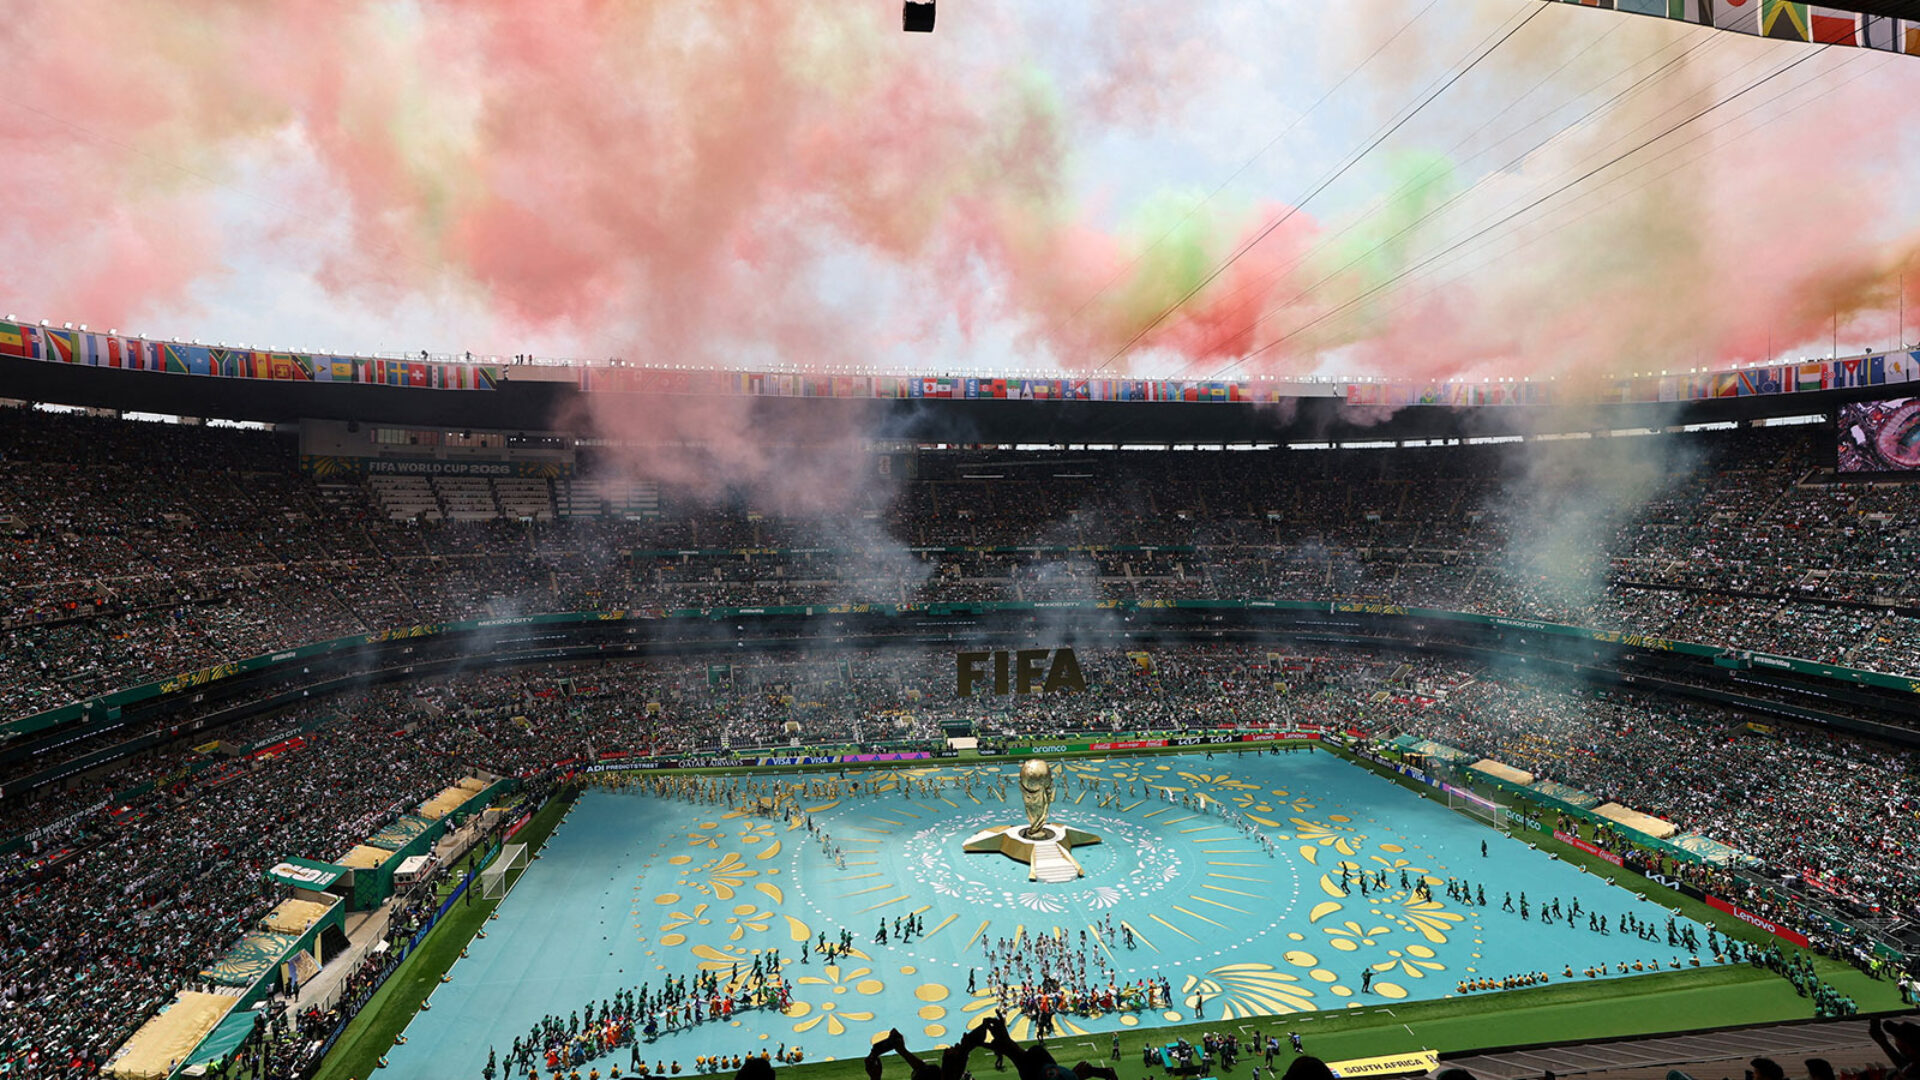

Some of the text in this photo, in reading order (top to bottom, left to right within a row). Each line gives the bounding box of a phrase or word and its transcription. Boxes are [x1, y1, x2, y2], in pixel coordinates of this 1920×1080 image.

[369, 462, 510, 474] FIFA WORLD CUP 2026
[478, 618, 512, 626] MEXICO
[1527, 622, 1545, 630] CITY
[957, 648, 1087, 698] FIFA
[254, 726, 303, 749] MEXICO CITY
[1284, 732, 1308, 740] Lenovo
[1032, 744, 1067, 753] aramco
[678, 759, 744, 768] QATAR AIRWAYS
[773, 757, 792, 766] VISA
[810, 756, 829, 764] VISA
[586, 762, 660, 773] ADI PREDICTSTREET
[24, 829, 42, 842] FIFA
[1733, 907, 1776, 933] Lenovo
[1344, 1064, 1383, 1074] SOUTH
[1384, 1059, 1424, 1070] AFRICA
